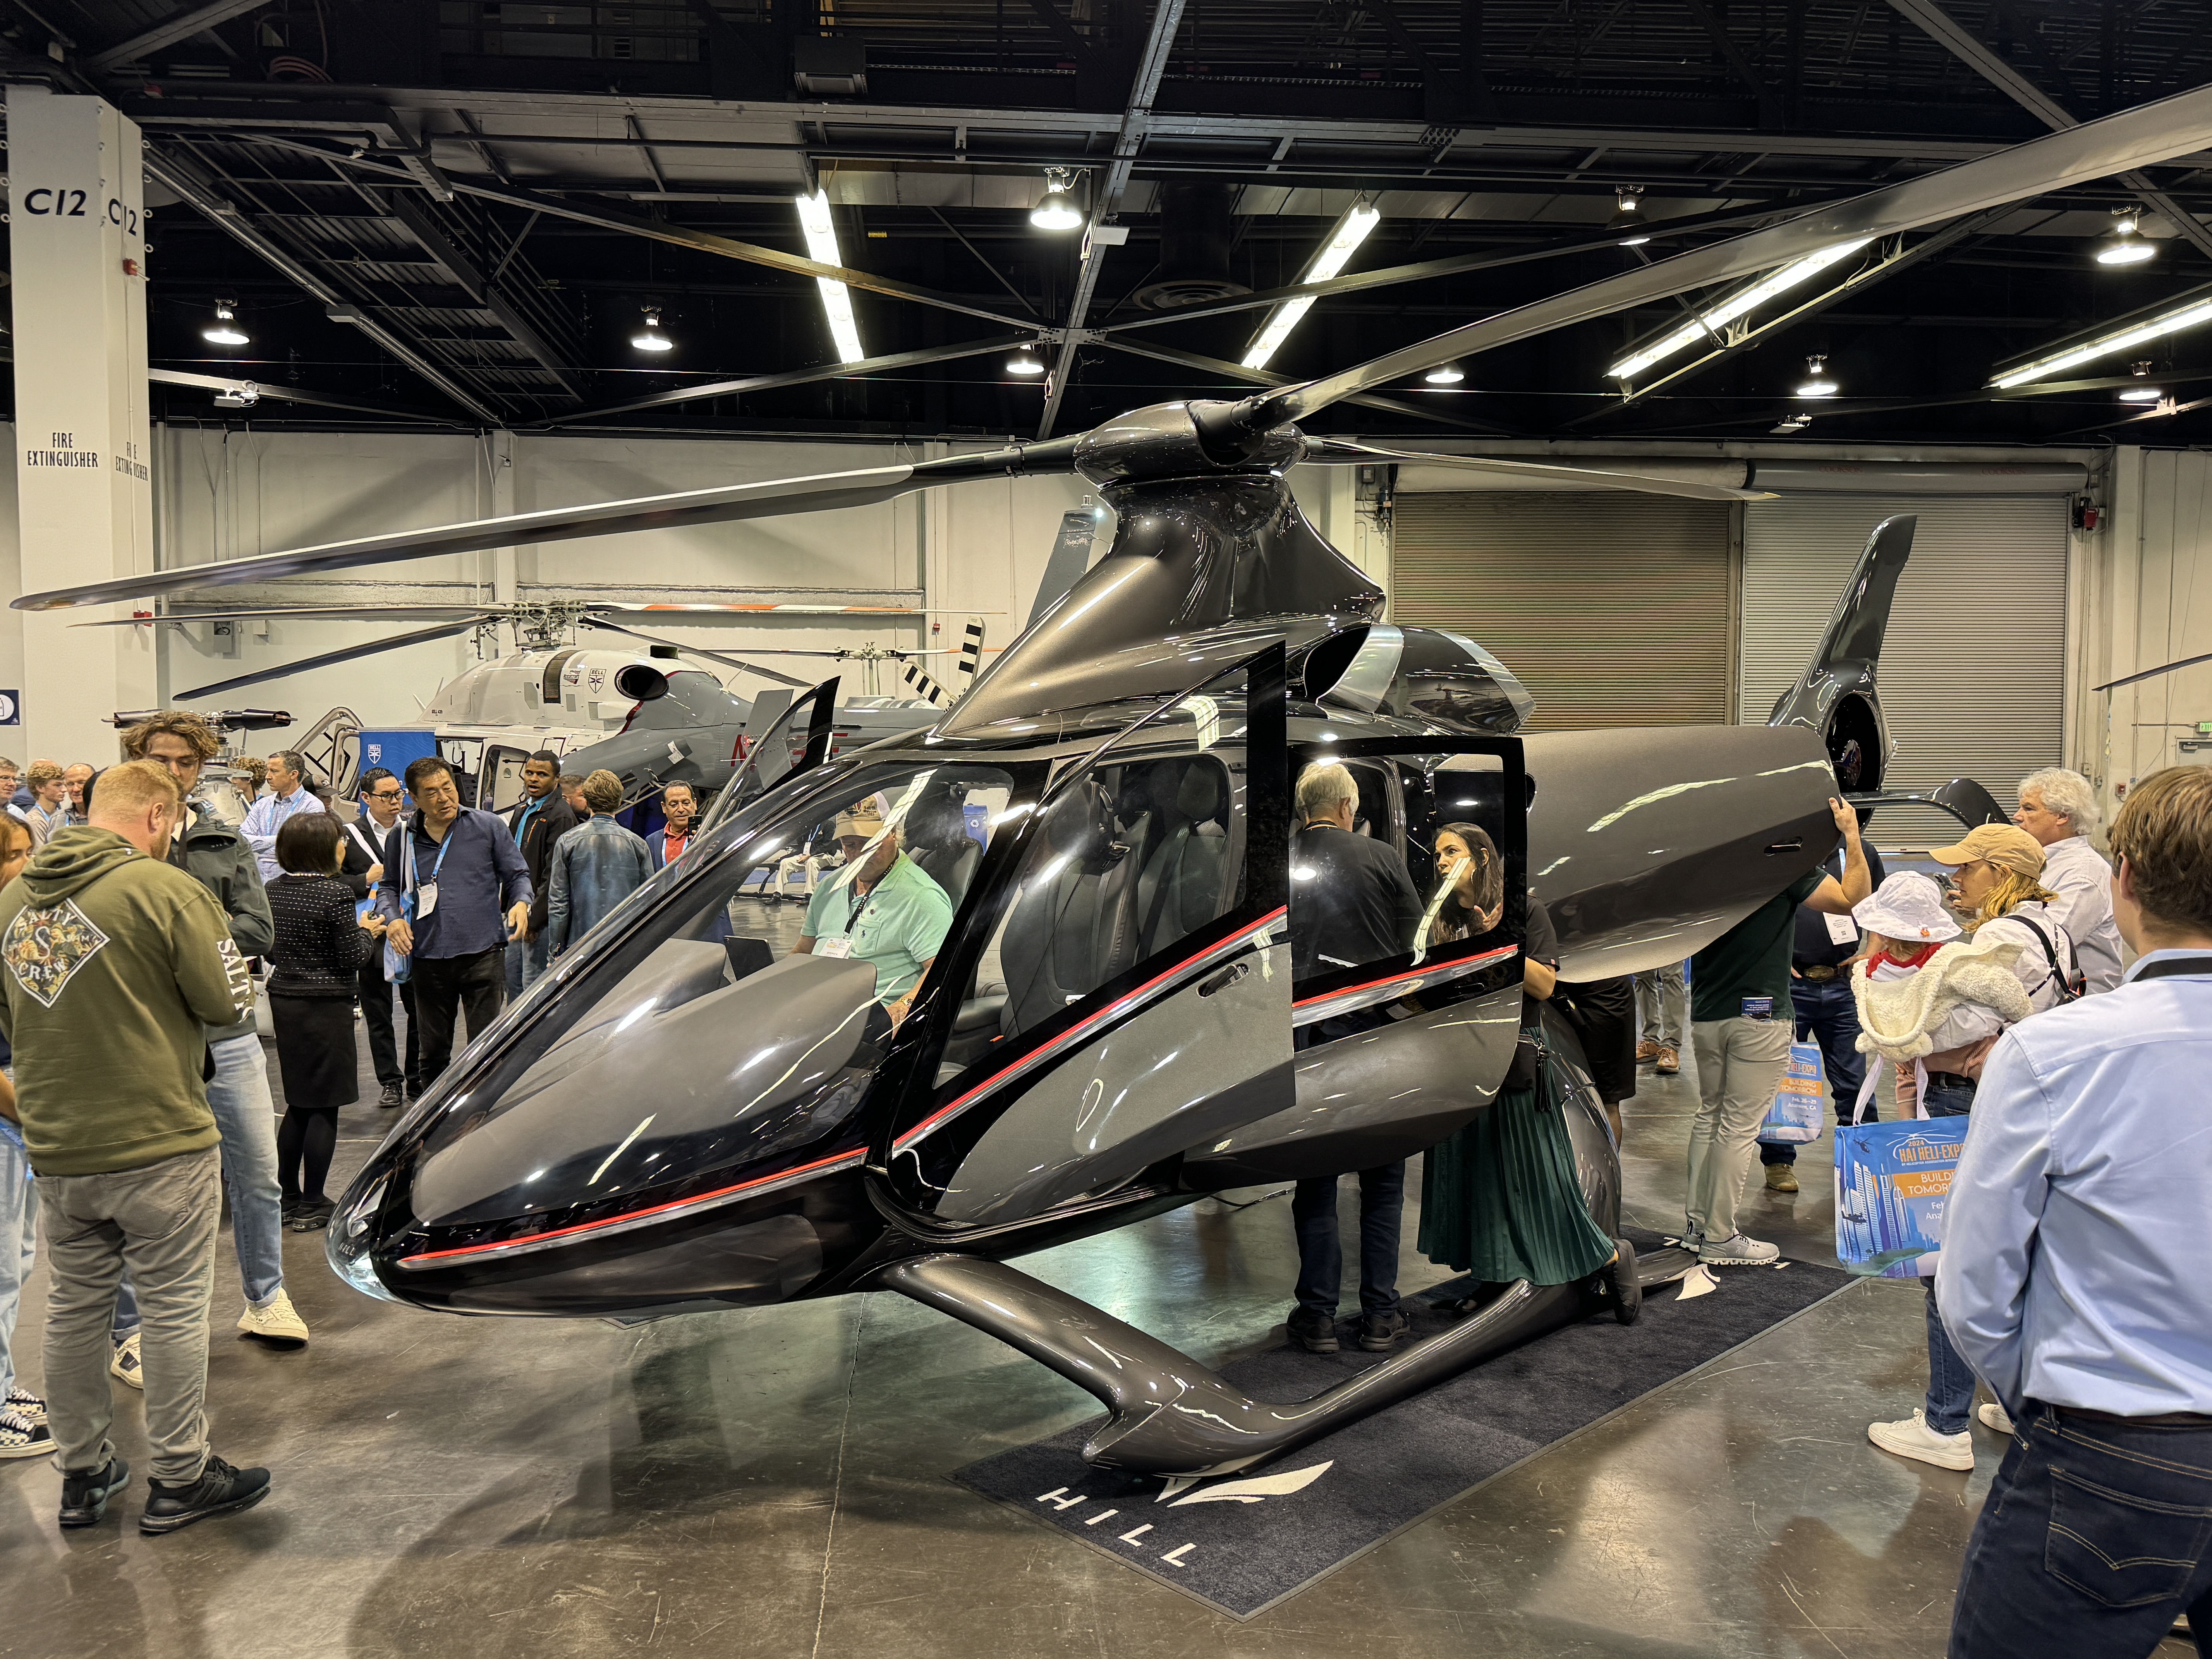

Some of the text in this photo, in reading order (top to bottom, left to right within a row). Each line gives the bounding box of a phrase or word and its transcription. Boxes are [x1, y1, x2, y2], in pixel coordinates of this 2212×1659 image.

[52, 432, 73, 448] FIRE
[27, 450, 98, 467] EXTINGUISHER
[127, 441, 137, 460] FIE
[16, 908, 77, 934] SALTY
[19, 958, 68, 980] CREW
[1899, 1147, 1917, 1162] HAI
[1921, 1171, 1954, 1183] BUILD
[1908, 1183, 1952, 1195] TOMOR
[1035, 1486, 1197, 1567] HILL
